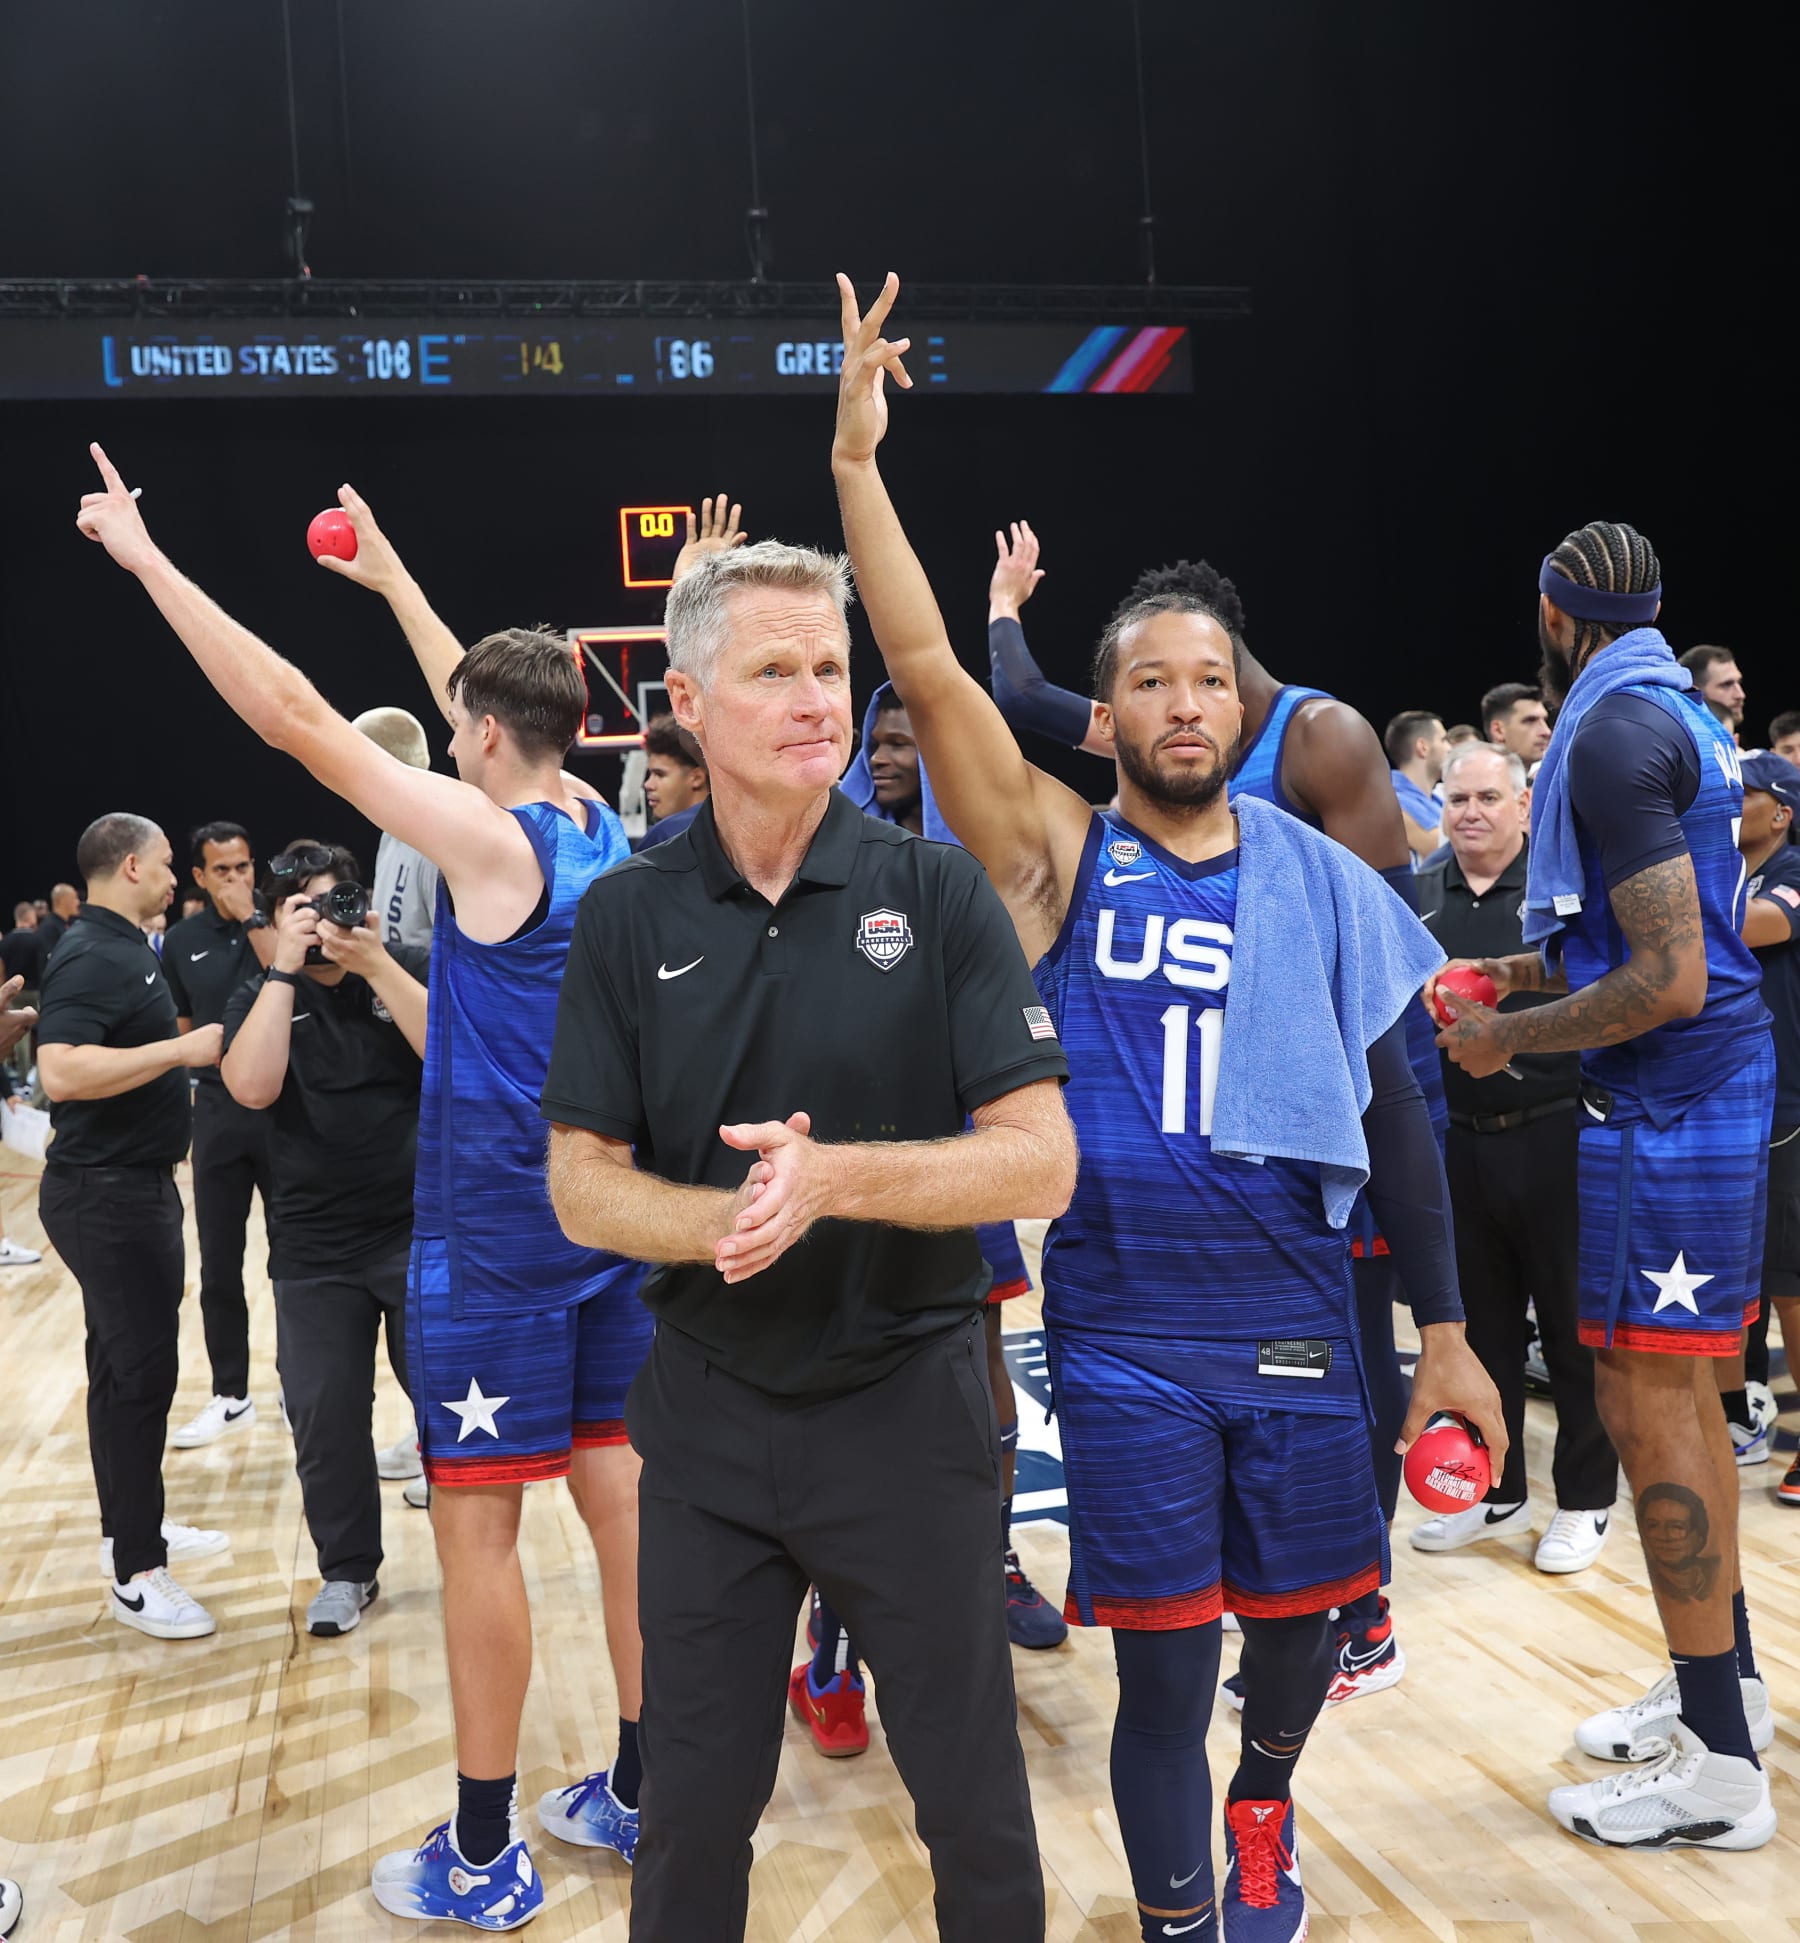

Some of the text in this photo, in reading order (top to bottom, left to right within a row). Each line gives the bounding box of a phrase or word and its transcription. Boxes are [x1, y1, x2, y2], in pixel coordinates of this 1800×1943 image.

[130, 339, 411, 380] UNITED STATES 108
[867, 919, 901, 934] USA
[1095, 909, 1234, 992] US
[1160, 1005, 1225, 1136] 11
[1261, 1347, 1271, 1356] 48
